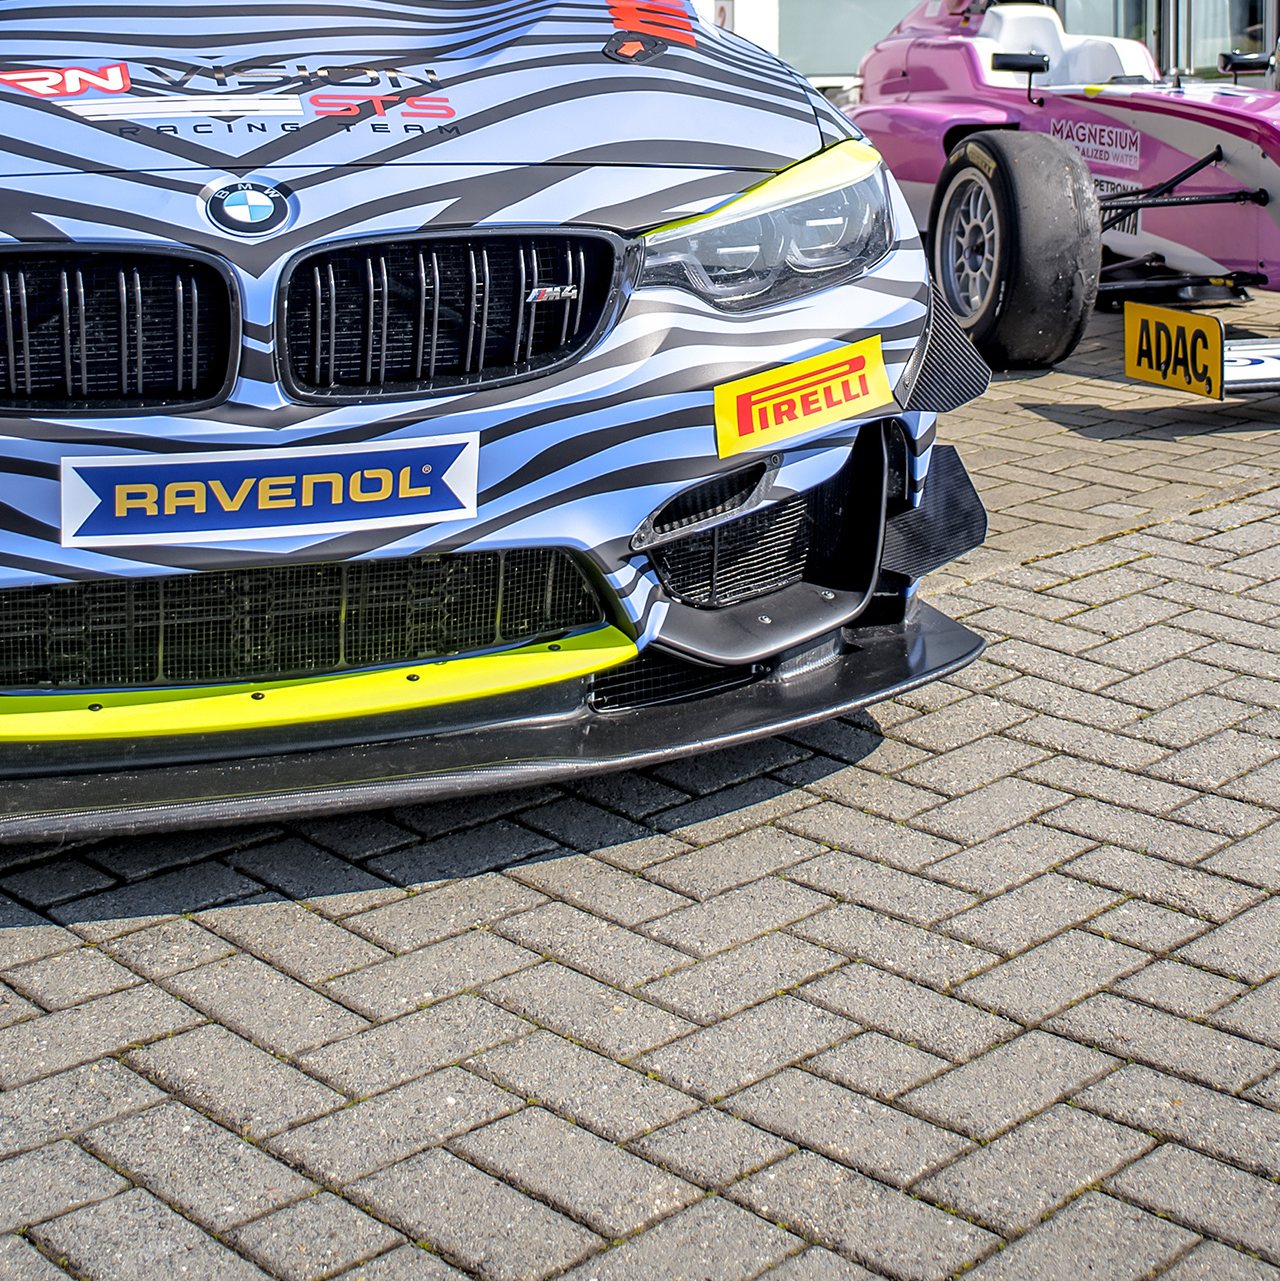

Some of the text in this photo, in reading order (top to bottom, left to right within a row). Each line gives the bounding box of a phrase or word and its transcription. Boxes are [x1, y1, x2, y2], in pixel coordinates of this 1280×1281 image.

[144, 65, 443, 90] VISION
[309, 94, 456, 119] STS
[117, 122, 463, 137] RACING TEAM
[1052, 122, 1138, 152] MAGNESIUM
[1111, 152, 1138, 167] WATER
[215, 183, 280, 200] BMW
[1136, 318, 1210, 384] ADAC
[736, 355, 869, 437] PIRELLI
